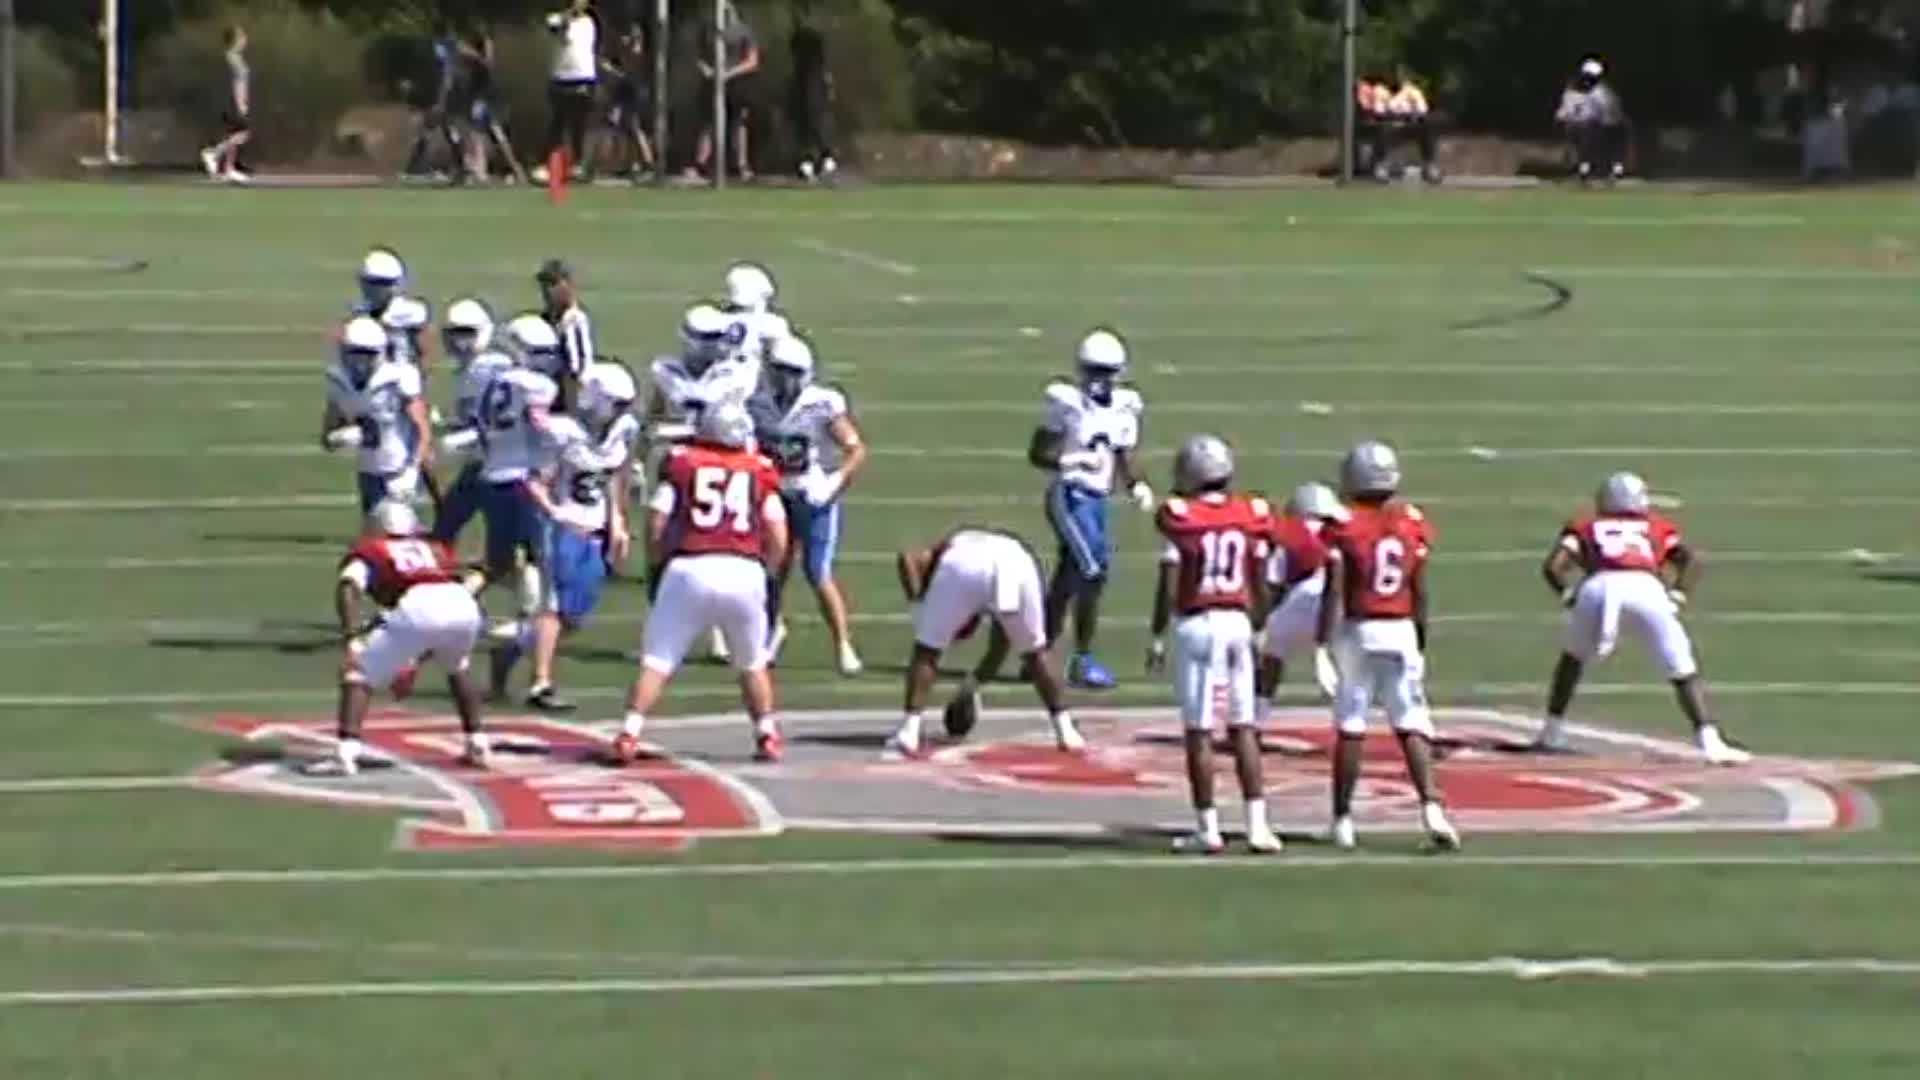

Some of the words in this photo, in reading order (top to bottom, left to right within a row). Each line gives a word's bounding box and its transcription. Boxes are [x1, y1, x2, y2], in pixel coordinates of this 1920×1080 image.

[690, 466, 750, 532] 54
[1202, 531, 1247, 594] 10
[1375, 538, 1404, 595] 6
